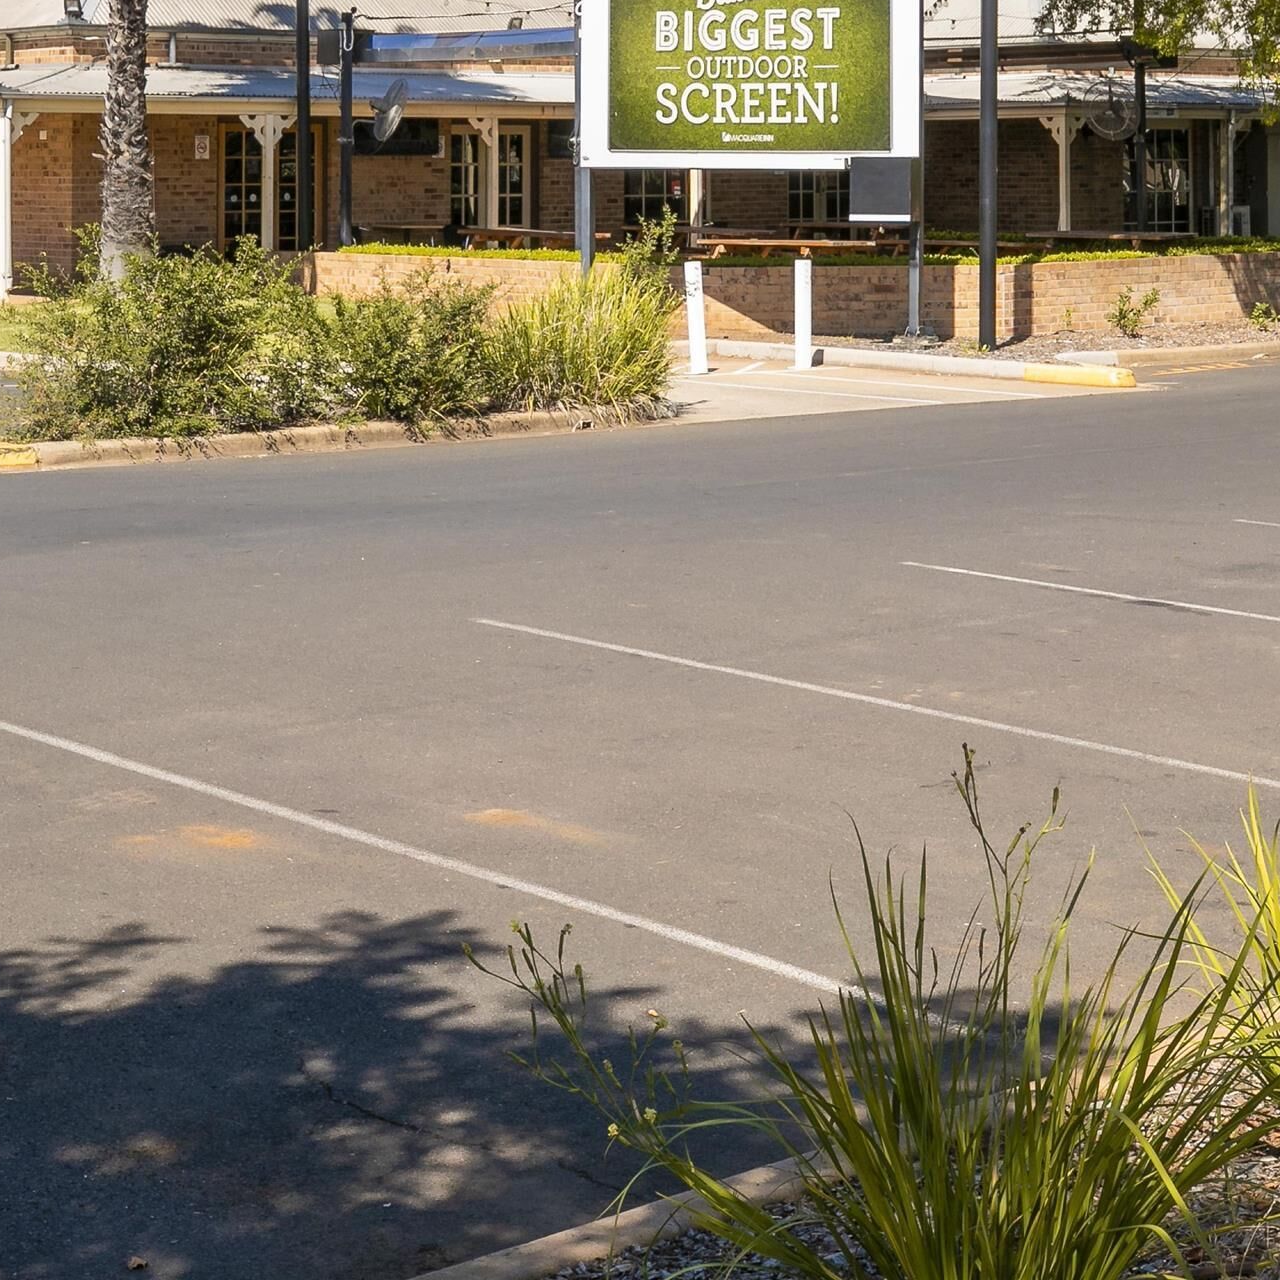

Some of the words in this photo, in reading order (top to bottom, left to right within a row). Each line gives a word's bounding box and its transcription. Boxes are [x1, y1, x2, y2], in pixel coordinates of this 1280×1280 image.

[655, 7, 840, 52] BIGGEST
[686, 55, 808, 79] OUTDOOR
[655, 82, 839, 124] SCREEN!
